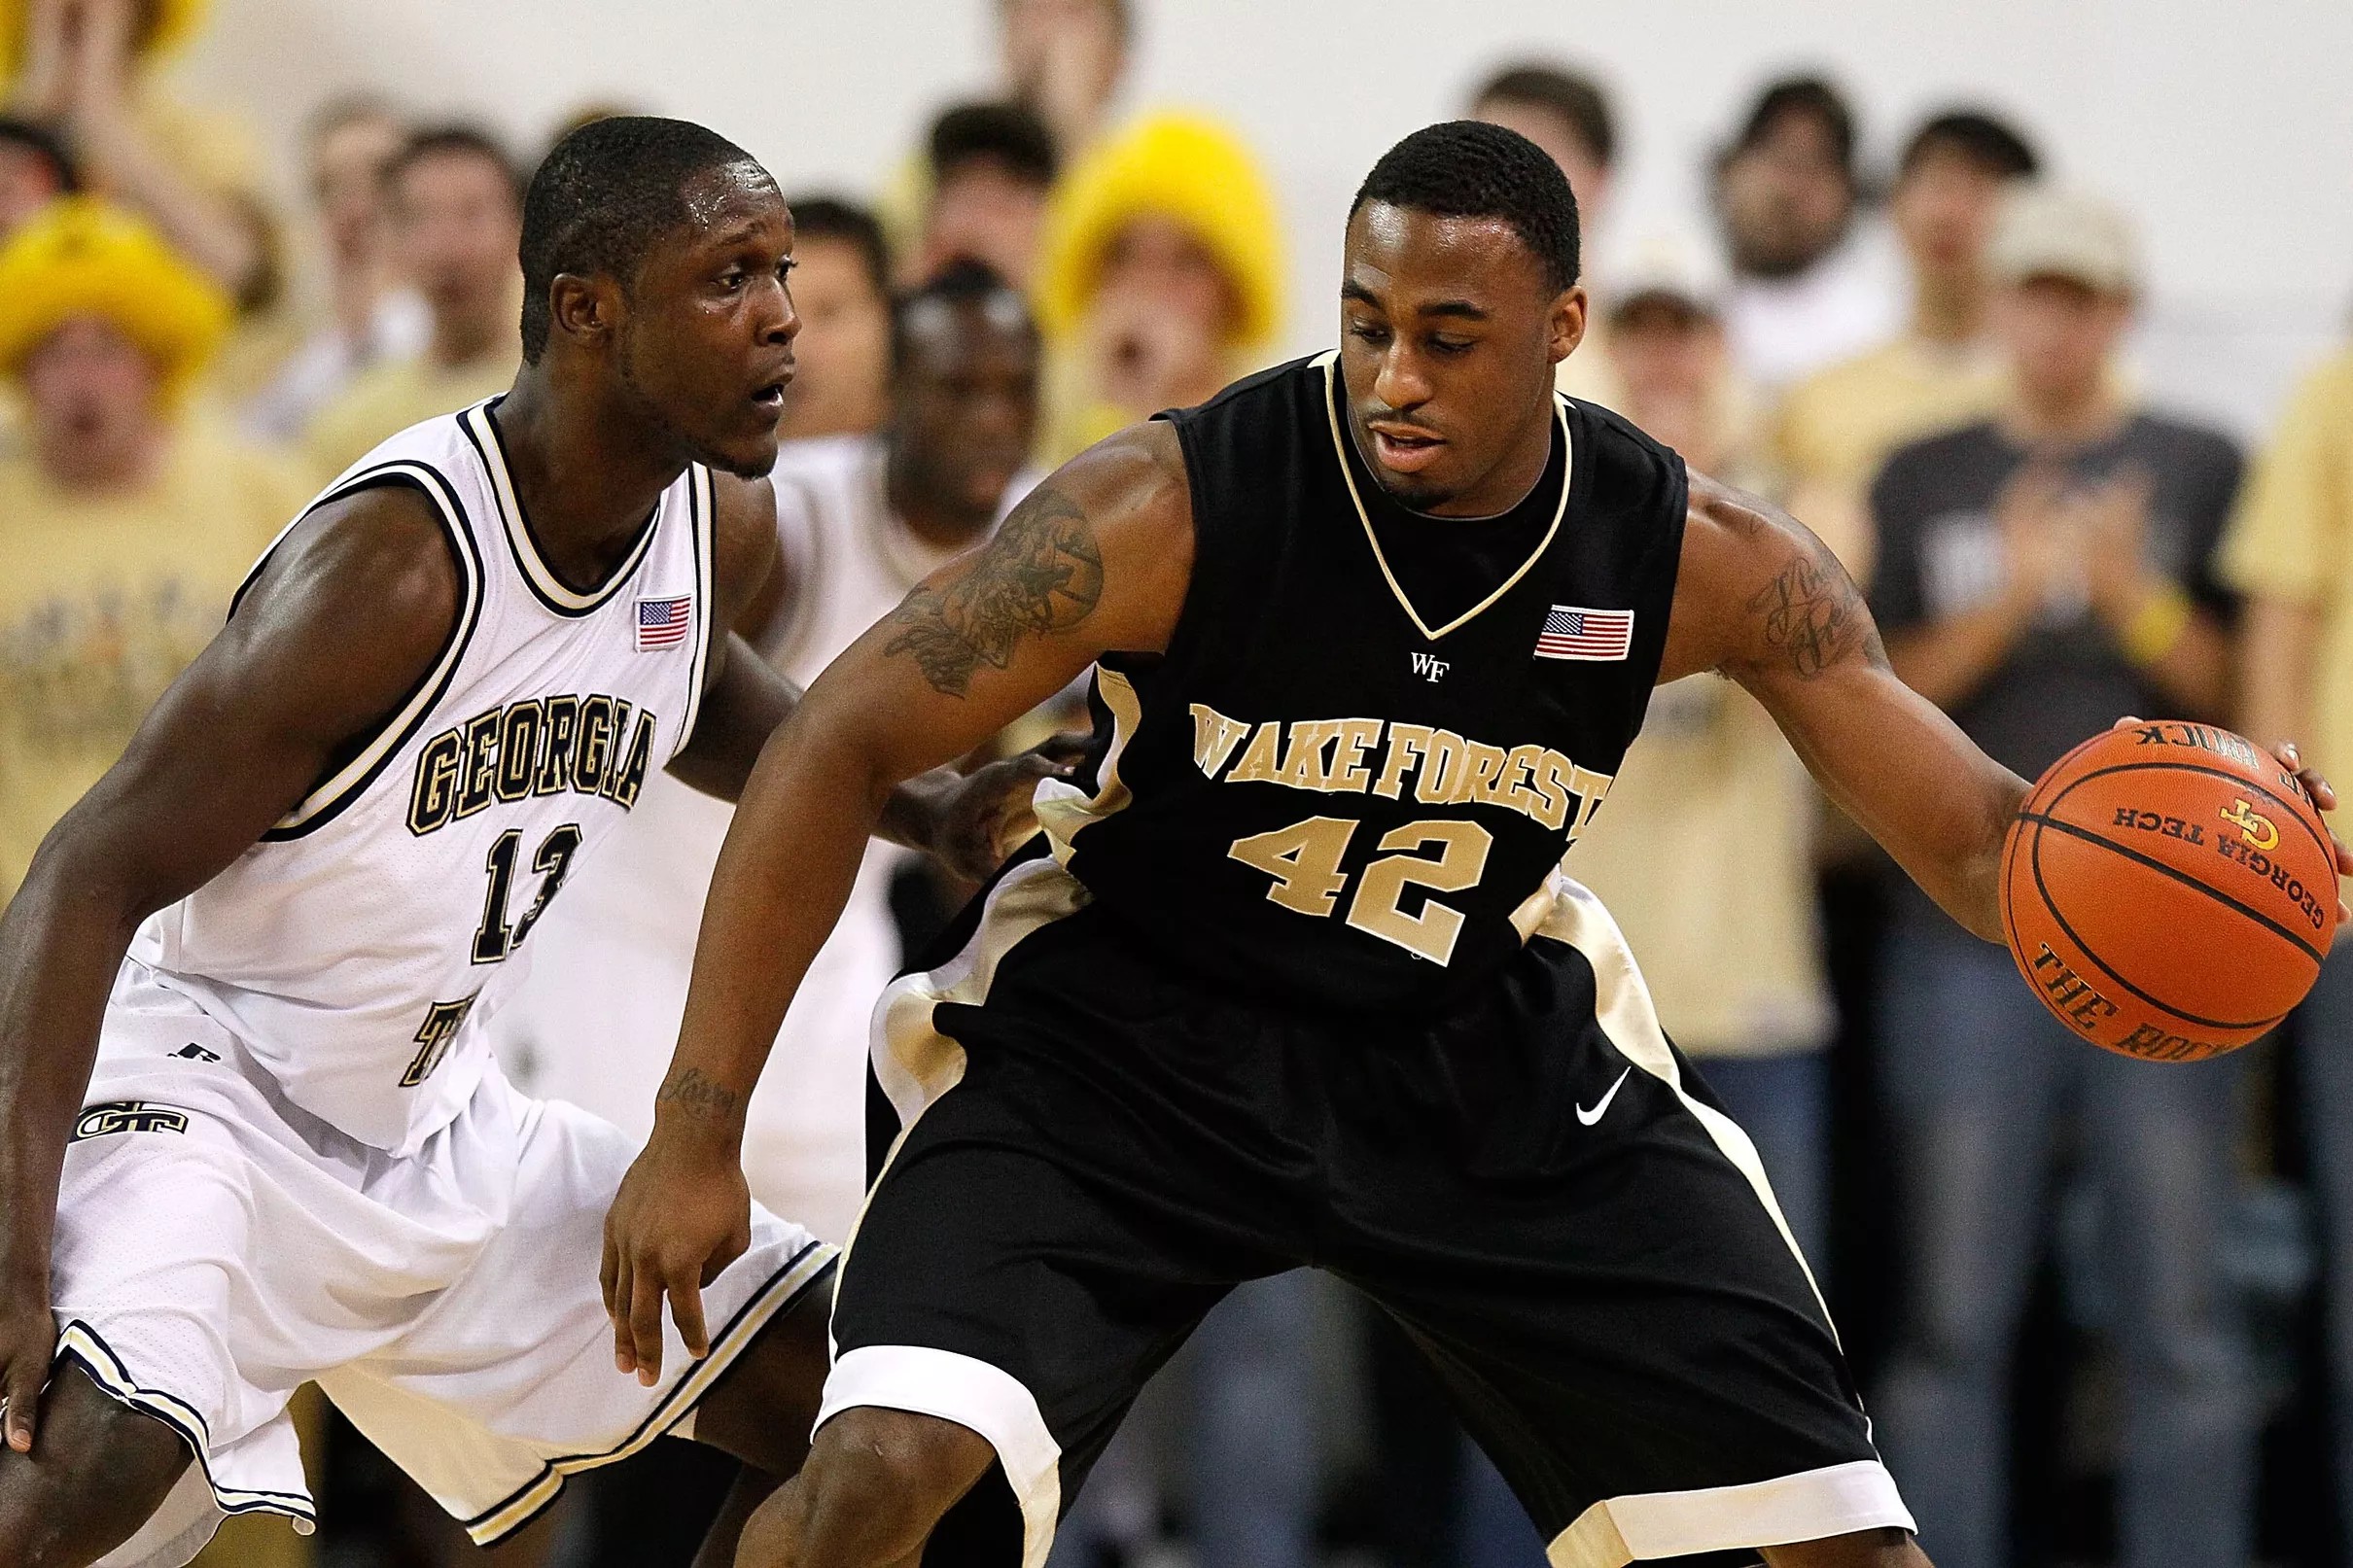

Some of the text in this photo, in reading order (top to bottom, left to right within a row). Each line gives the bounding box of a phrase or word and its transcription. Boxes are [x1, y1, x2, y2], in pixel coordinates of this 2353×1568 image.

[1410, 651, 1450, 682] WF
[405, 694, 656, 837] GEORGIA
[1188, 703, 1615, 842] WAKE FOREST
[471, 823, 582, 965] 13
[1226, 816, 1493, 967] 42
[2112, 807, 2325, 929] GEORGIA TECH
[2032, 941, 2233, 1060] THE ROC
